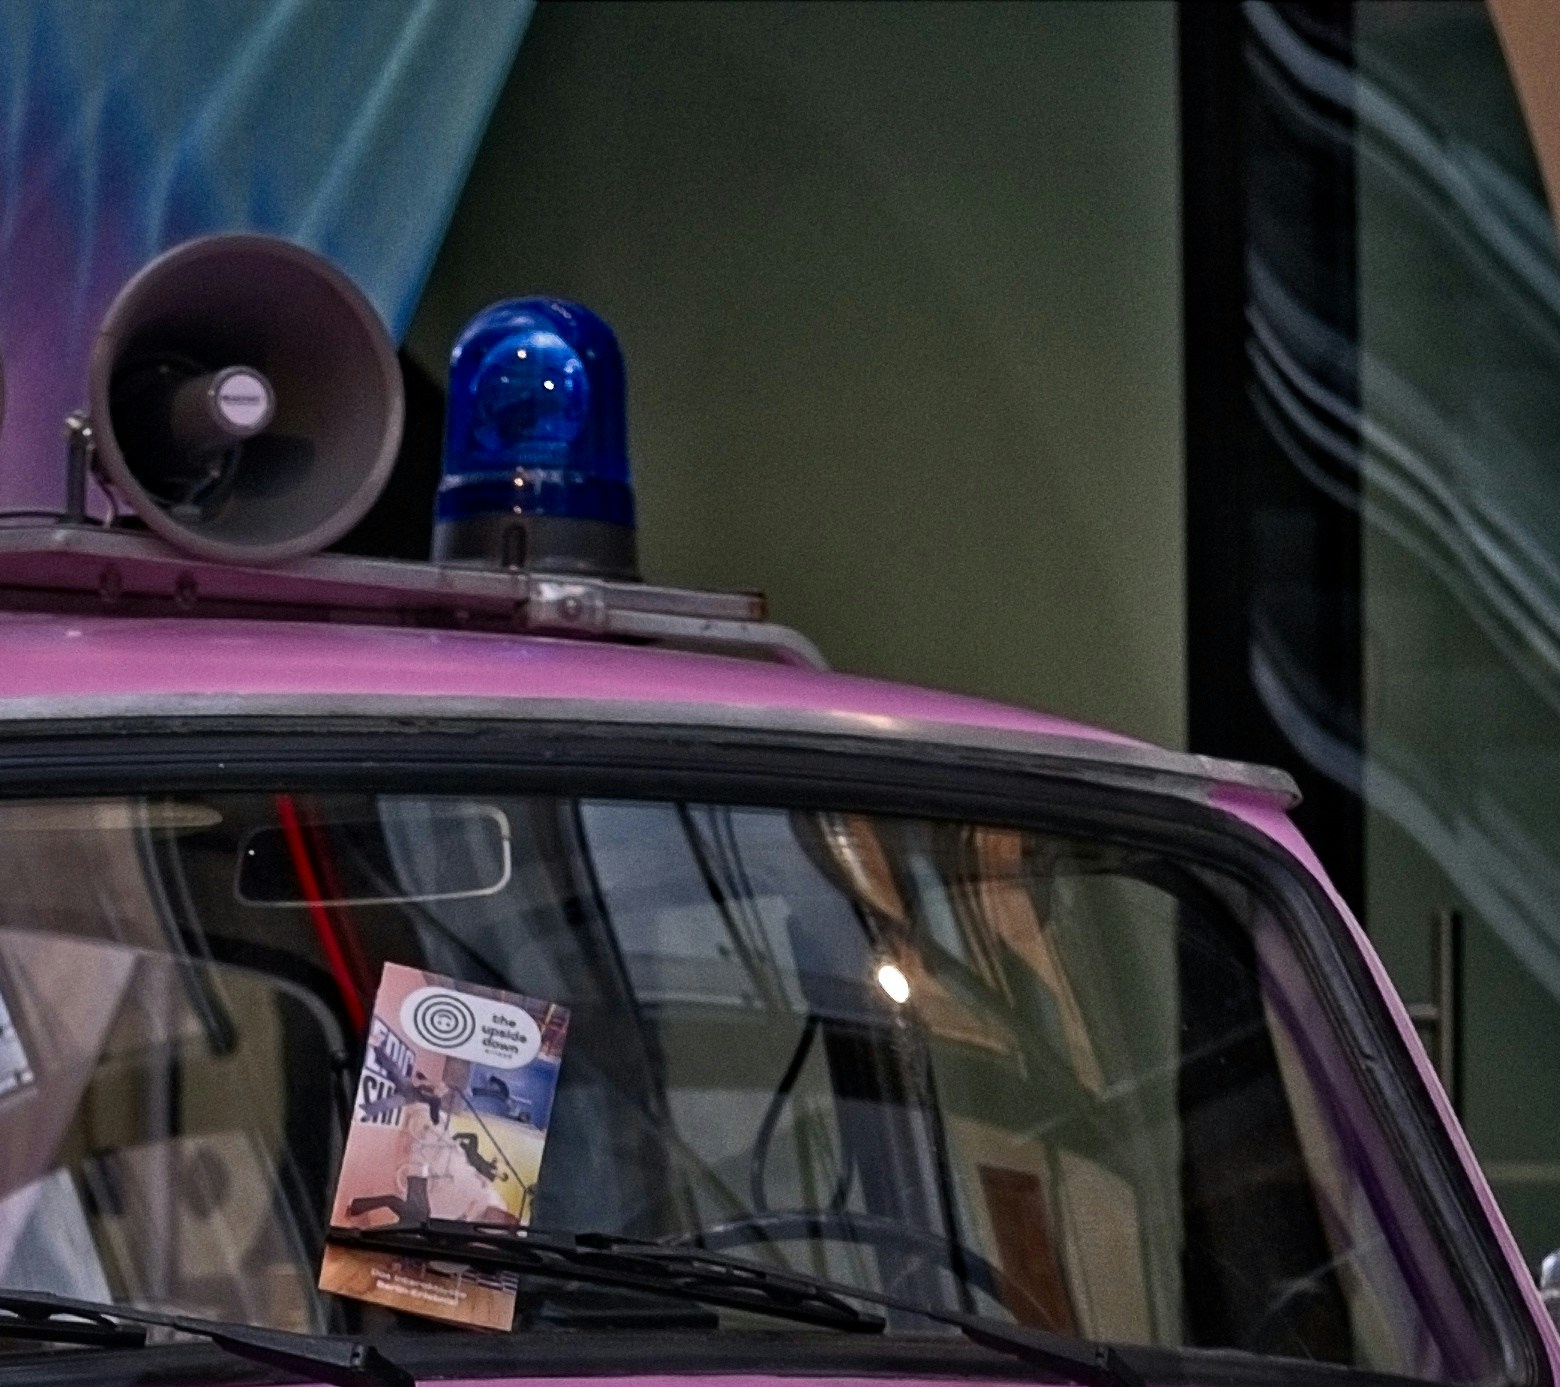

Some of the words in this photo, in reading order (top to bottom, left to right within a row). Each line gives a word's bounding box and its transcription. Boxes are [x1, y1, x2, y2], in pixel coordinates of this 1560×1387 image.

[492, 1014, 517, 1028] the
[481, 1025, 527, 1044] upside
[482, 1037, 519, 1054] down
